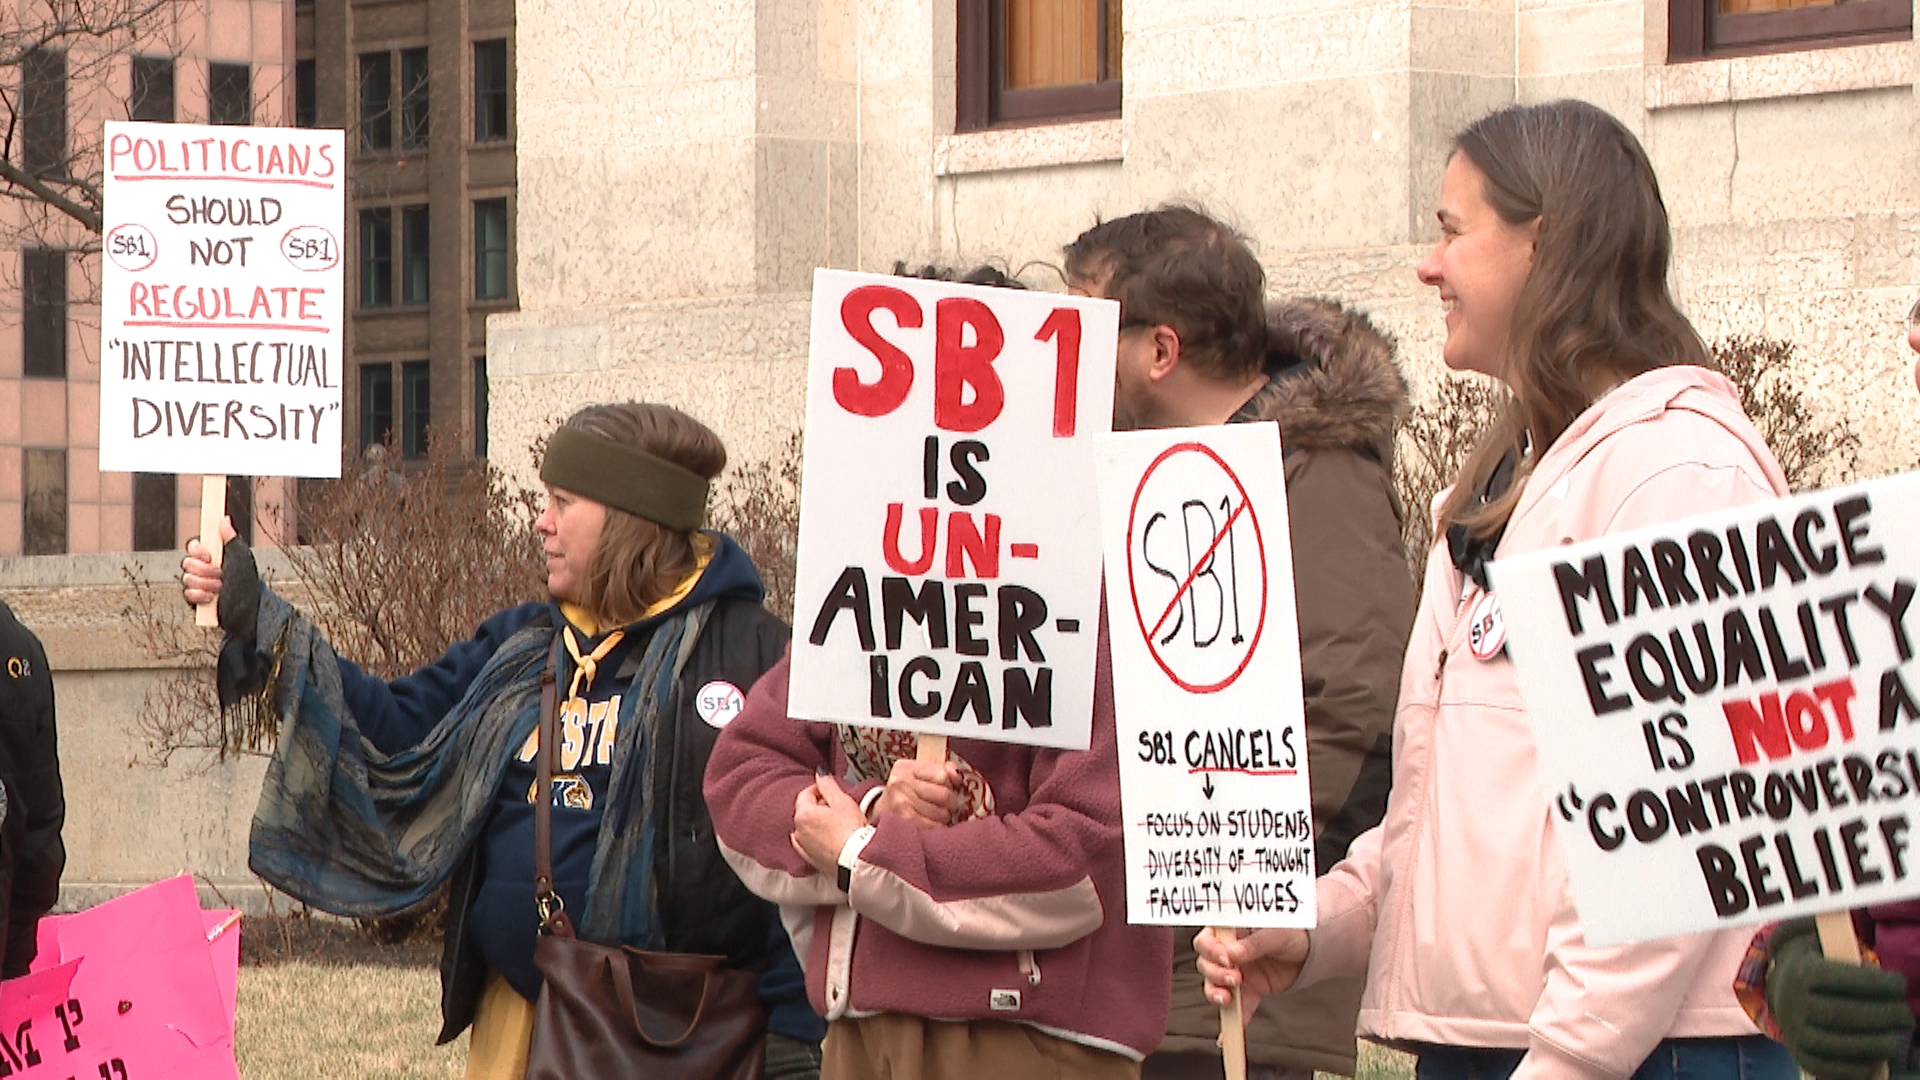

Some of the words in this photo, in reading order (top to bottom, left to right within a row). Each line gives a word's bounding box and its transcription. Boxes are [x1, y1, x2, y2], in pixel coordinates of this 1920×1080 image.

[110, 133, 335, 178] POLITICIANS
[166, 194, 282, 226] SHOULD
[112, 235, 150, 257] SB1
[190, 237, 253, 267] NOT
[288, 237, 333, 261] SB1
[130, 281, 325, 321] REGULATE
[108, 338, 338, 389] "INTELLECTUAL
[132, 397, 339, 444] DIVERSITY"
[923, 435, 990, 506] IS
[882, 502, 1039, 579] UN-
[1143, 495, 1245, 648] SB1
[809, 566, 1081, 663] AMER-
[1575, 576, 1917, 717] EQUALITY
[703, 697, 741, 712] SB1
[1642, 711, 1695, 773] IS
[1722, 676, 1856, 766] NOT
[1877, 668, 1920, 735] A
[1138, 730, 1177, 765] SB1
[1184, 725, 1297, 770] CANCELS
[1146, 811, 1193, 838] FOCUS
[1197, 811, 1221, 837] ON
[1227, 807, 1310, 842] STUDENTS
[1149, 846, 1221, 879] DIVERSITY
[1229, 848, 1244, 873] OF
[1255, 847, 1311, 877] THOUGHT
[1696, 814, 1911, 919] BELIEF
[1150, 881, 1222, 918] FACULTY
[1234, 880, 1299, 914] VOICES
